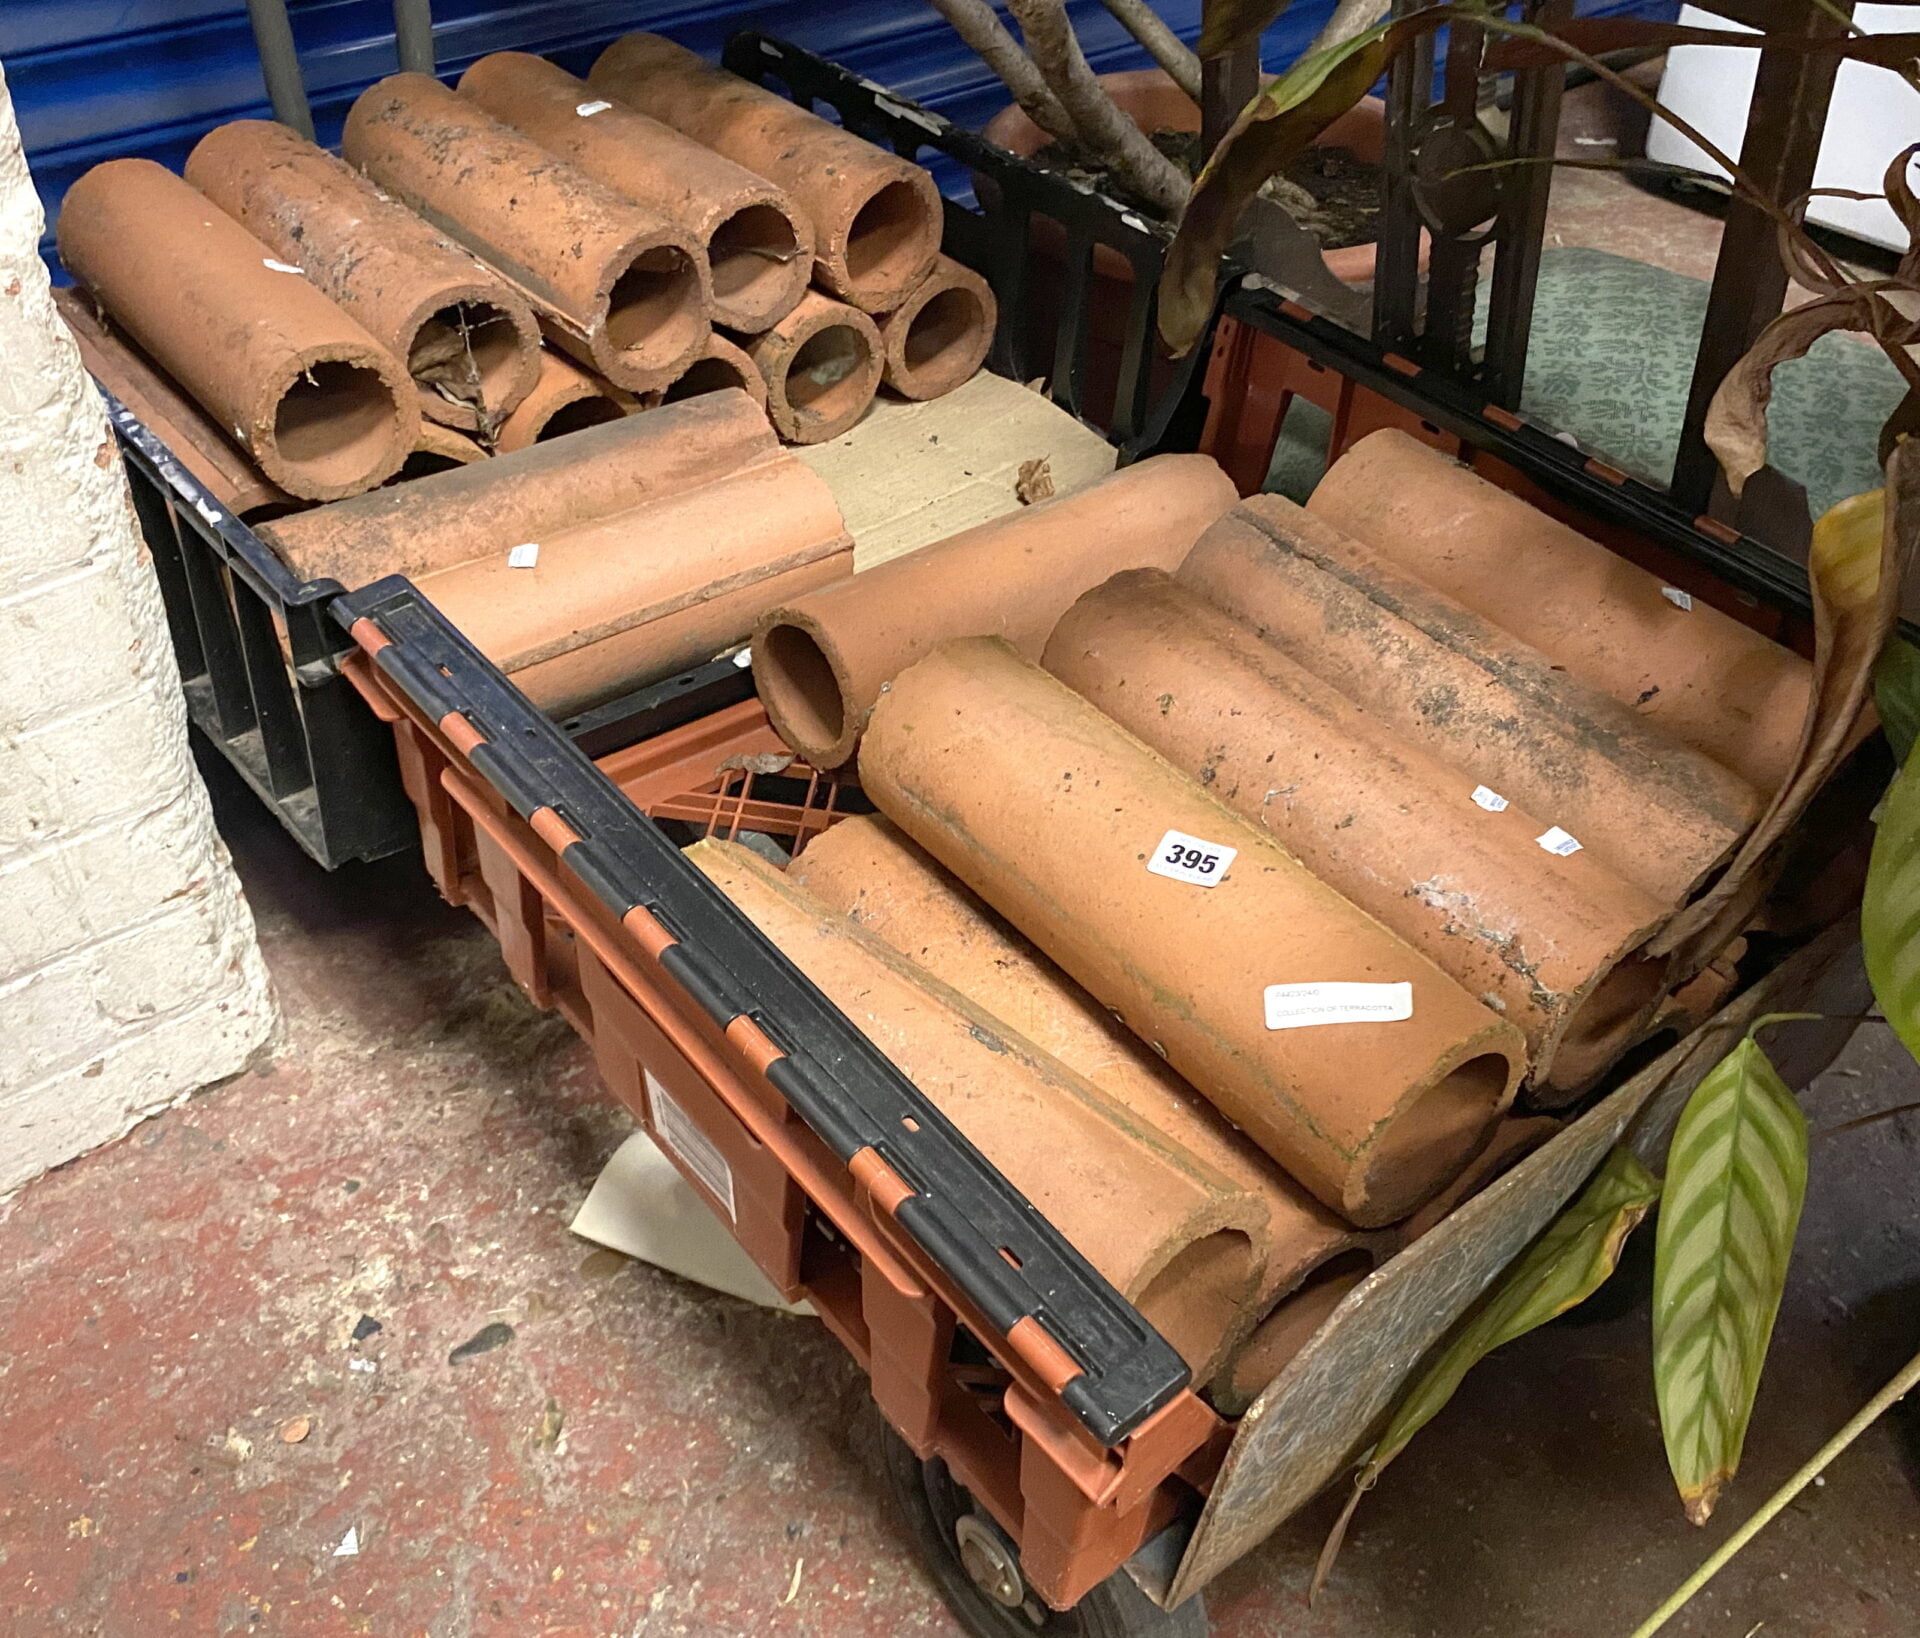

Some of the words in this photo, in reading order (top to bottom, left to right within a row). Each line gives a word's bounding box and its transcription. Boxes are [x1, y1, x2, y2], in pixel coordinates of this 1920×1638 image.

[1165, 844, 1219, 874] 395
[1276, 1006, 1325, 1017] COLLECTION
[1339, 1004, 1393, 1012] TERRACOTTA
